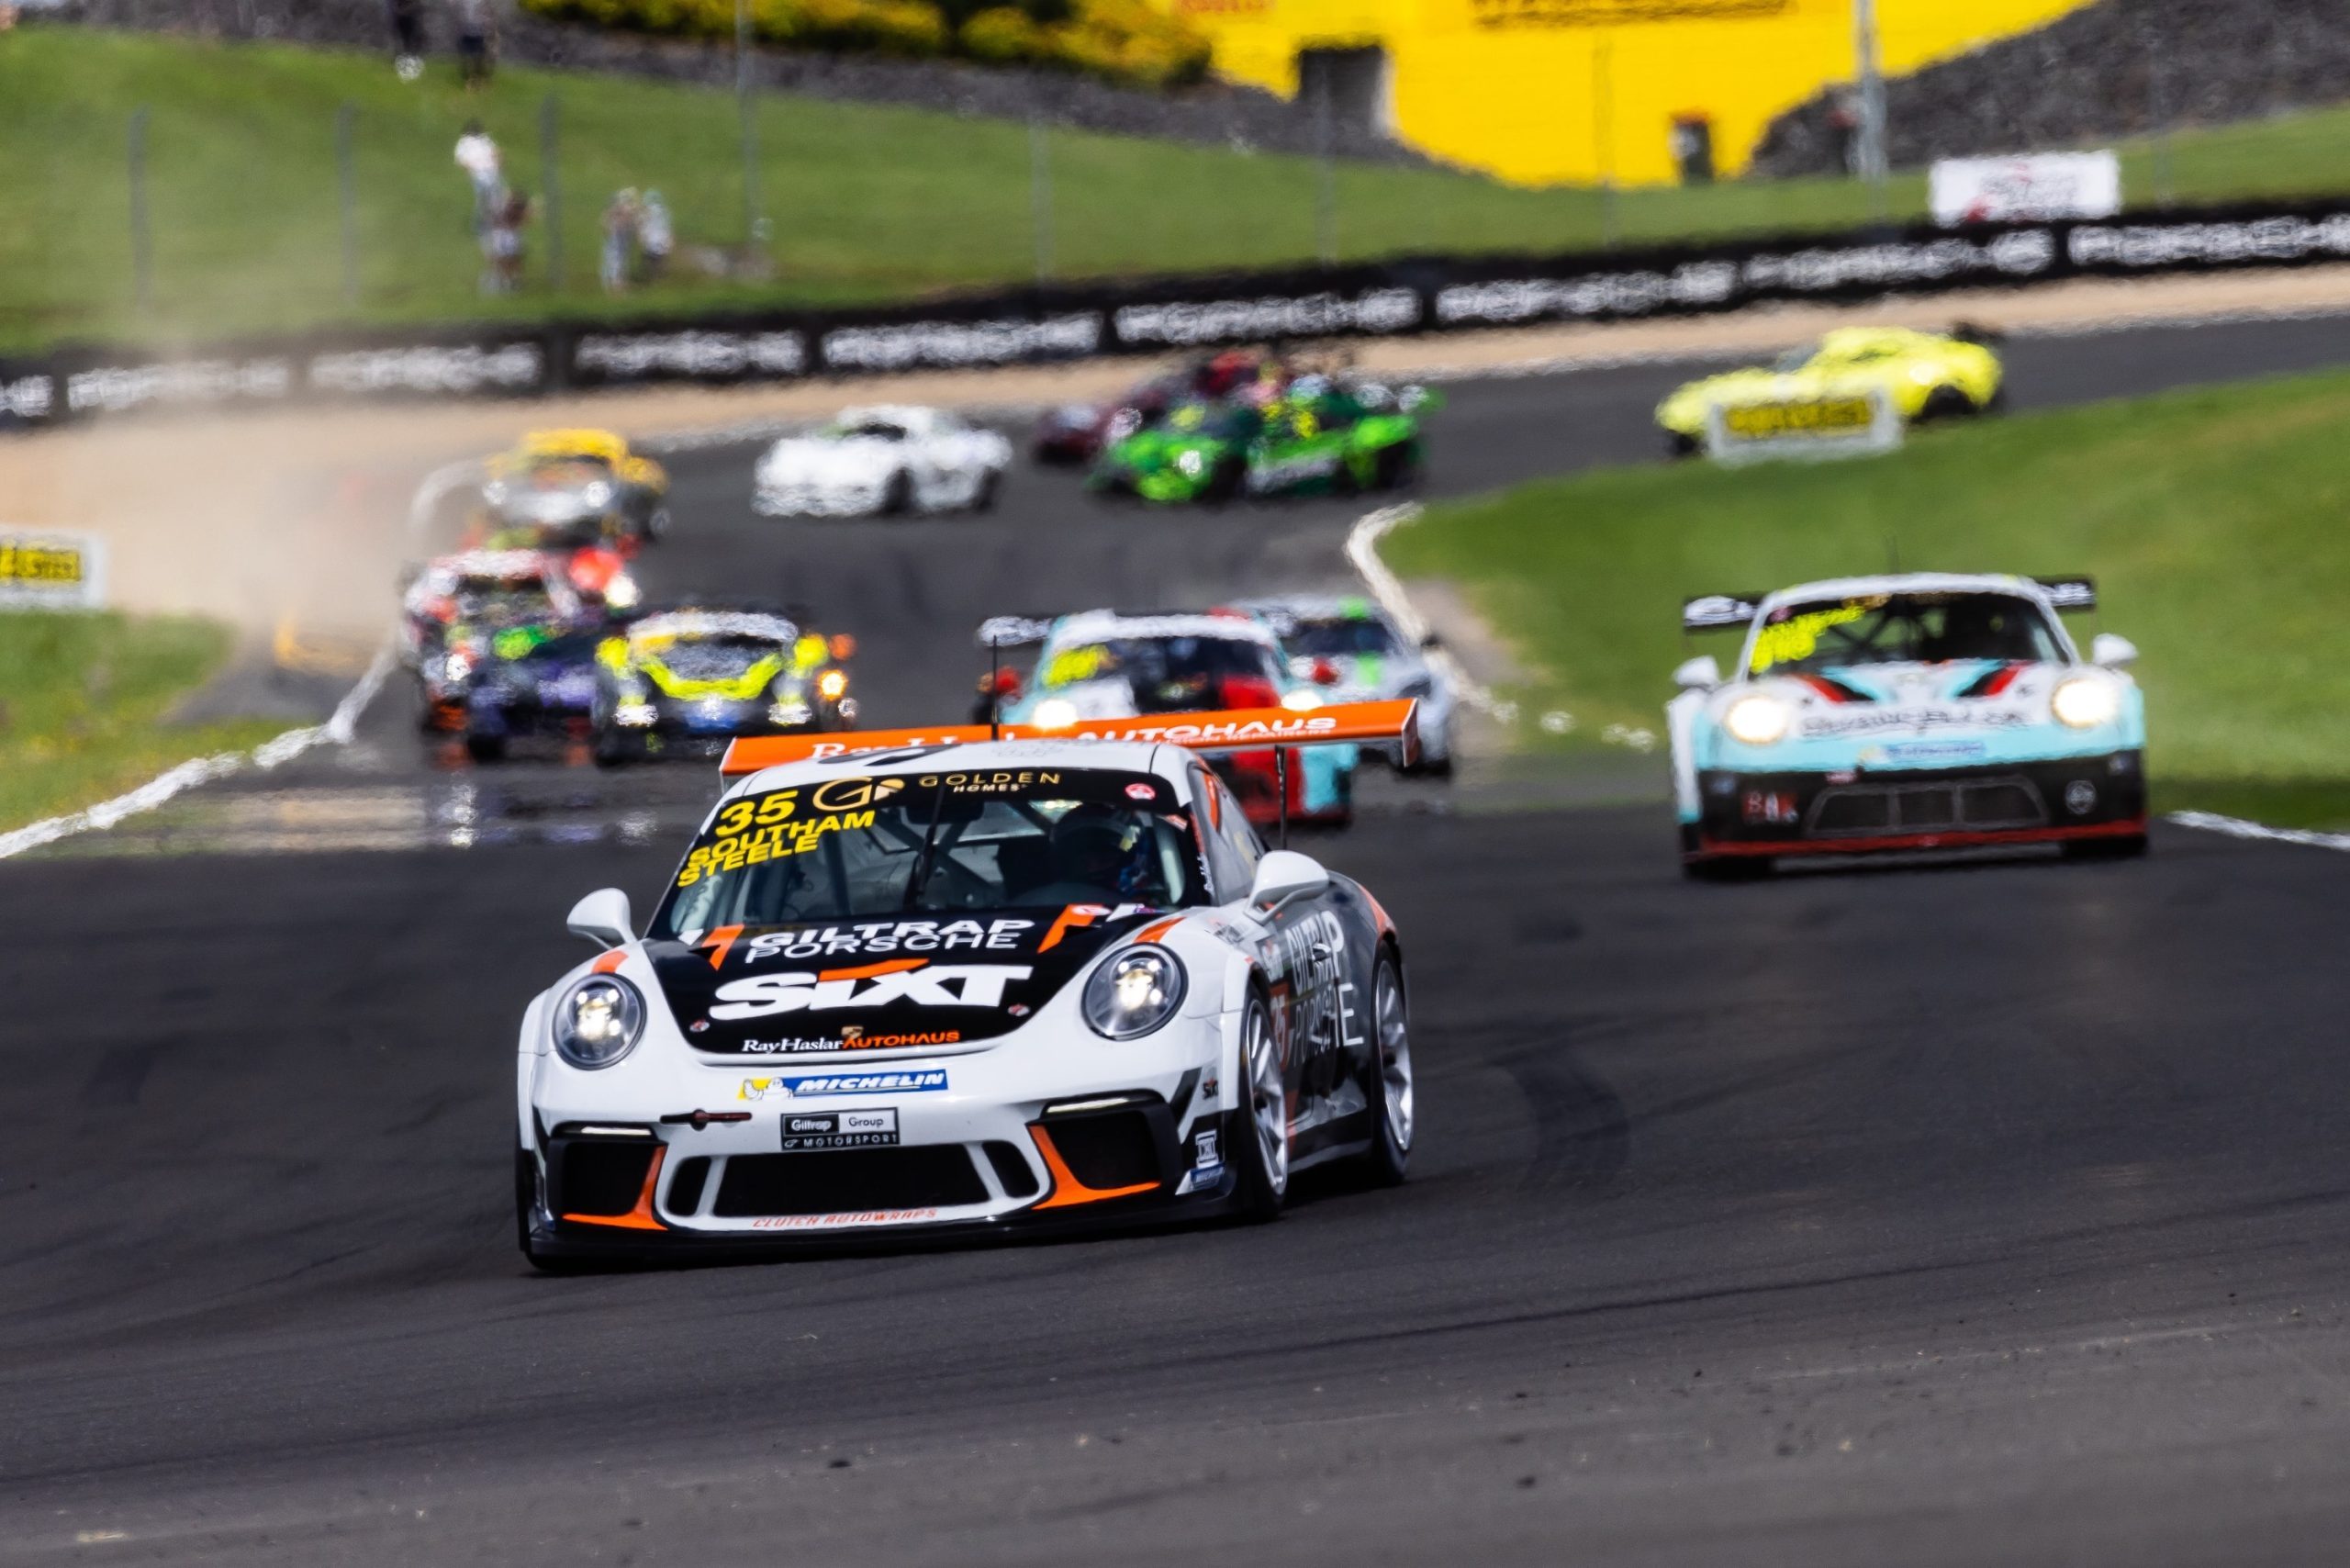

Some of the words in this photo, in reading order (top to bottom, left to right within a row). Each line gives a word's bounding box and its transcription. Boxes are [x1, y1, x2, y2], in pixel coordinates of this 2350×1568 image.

[919, 772, 1060, 787] GOLDEN
[953, 783, 1018, 792] HOMES
[715, 790, 798, 837] 35
[688, 811, 875, 868] SOUTHAM
[677, 833, 820, 887] STEELE
[749, 919, 1035, 948] GILTRAP
[744, 932, 1021, 963] PORSCHE
[843, 1030, 960, 1049] AUTOHAUS
[795, 1072, 945, 1092] MICHELIN
[791, 1119, 832, 1131] Giltrap
[848, 1116, 883, 1128] Group
[803, 1134, 897, 1148] MOTORSPORT
[752, 1215, 819, 1227] CLUTCH
[825, 1208, 938, 1225] AUTOWRAPS
